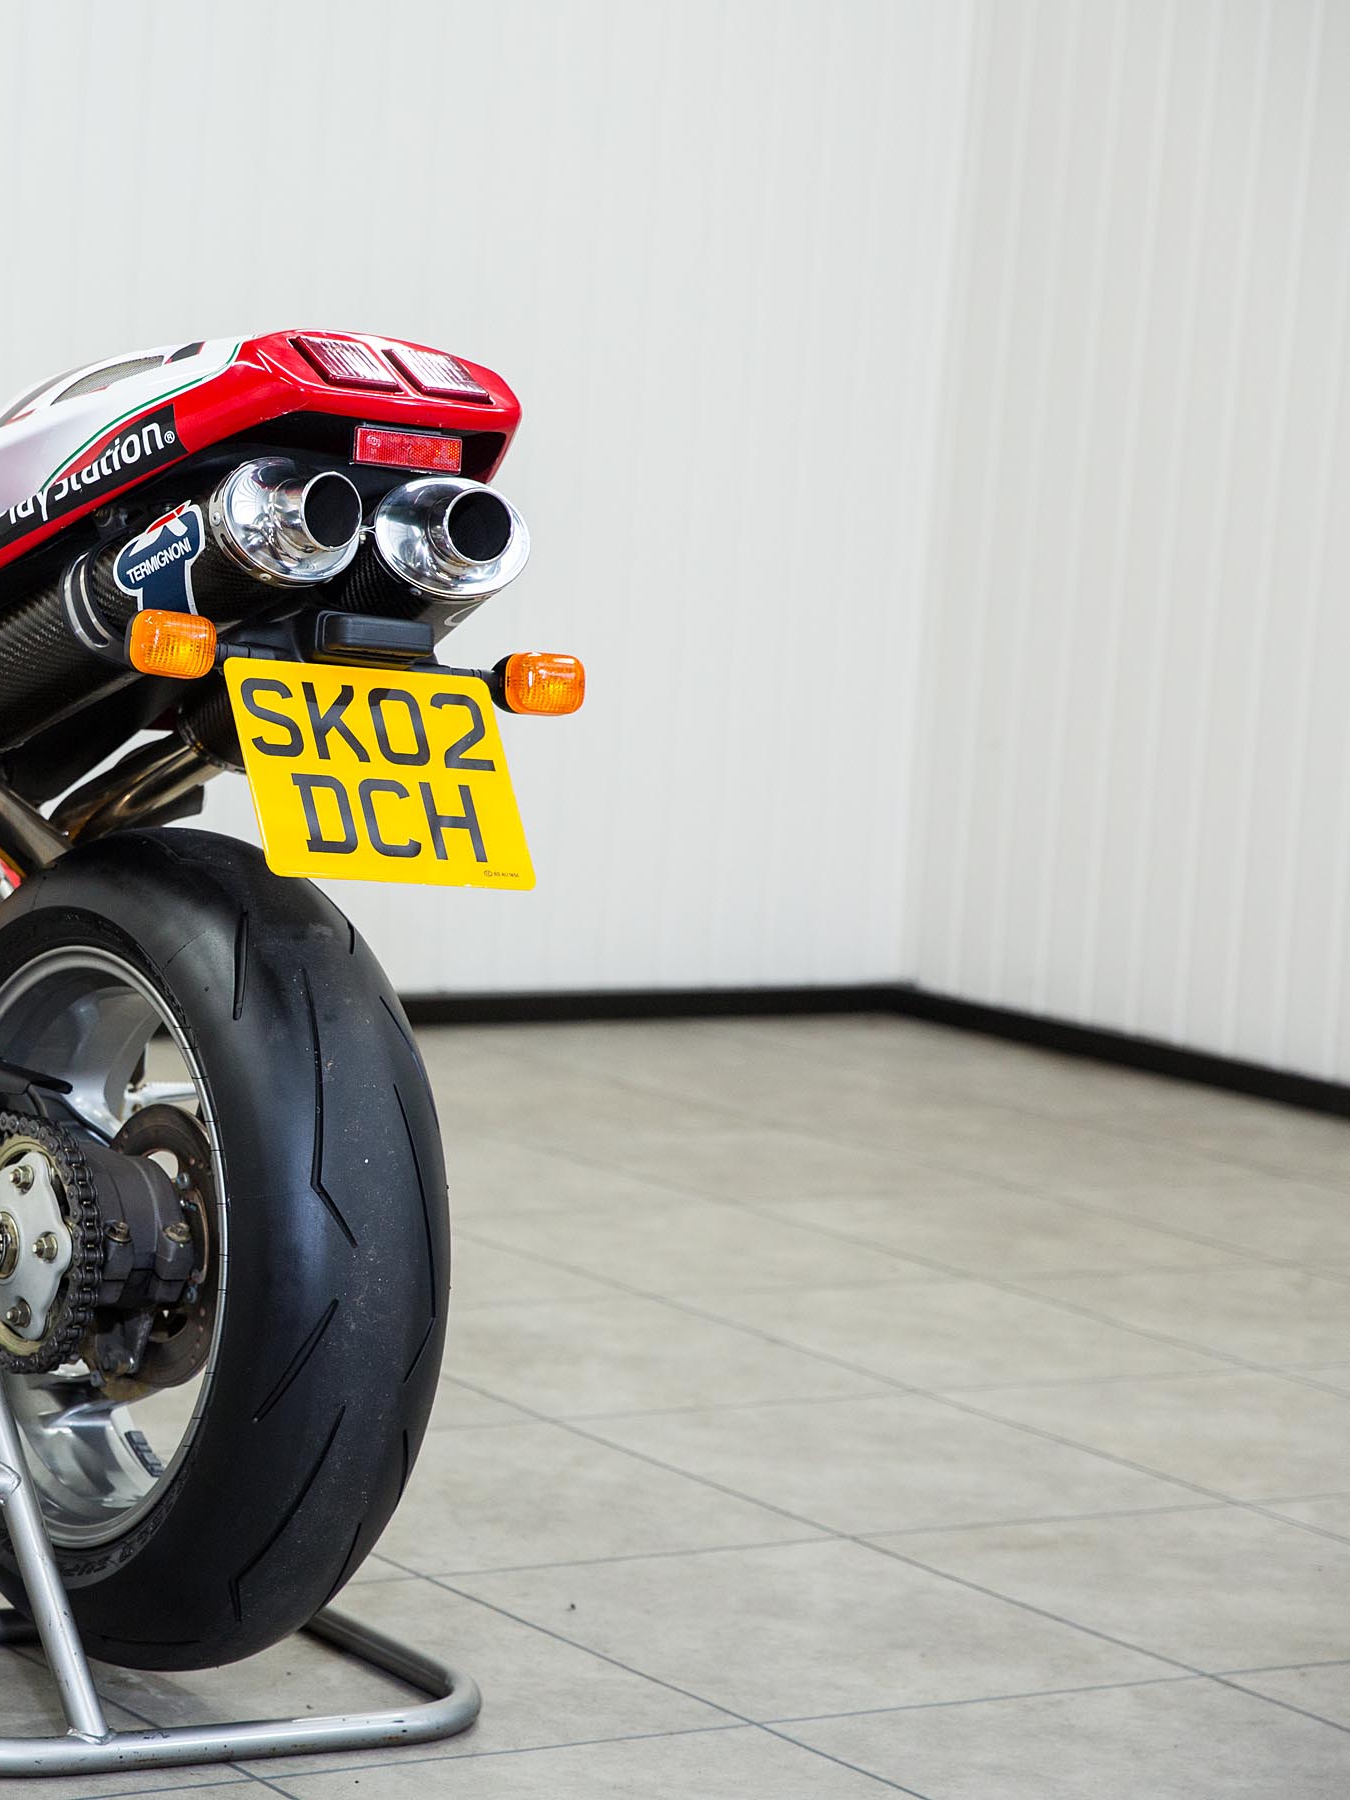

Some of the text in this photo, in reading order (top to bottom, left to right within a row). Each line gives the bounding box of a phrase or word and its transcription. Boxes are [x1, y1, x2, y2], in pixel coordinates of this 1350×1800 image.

[126, 537, 192, 584] TERMIGNONI
[240, 677, 496, 772] SK02
[291, 773, 488, 863] DCH
